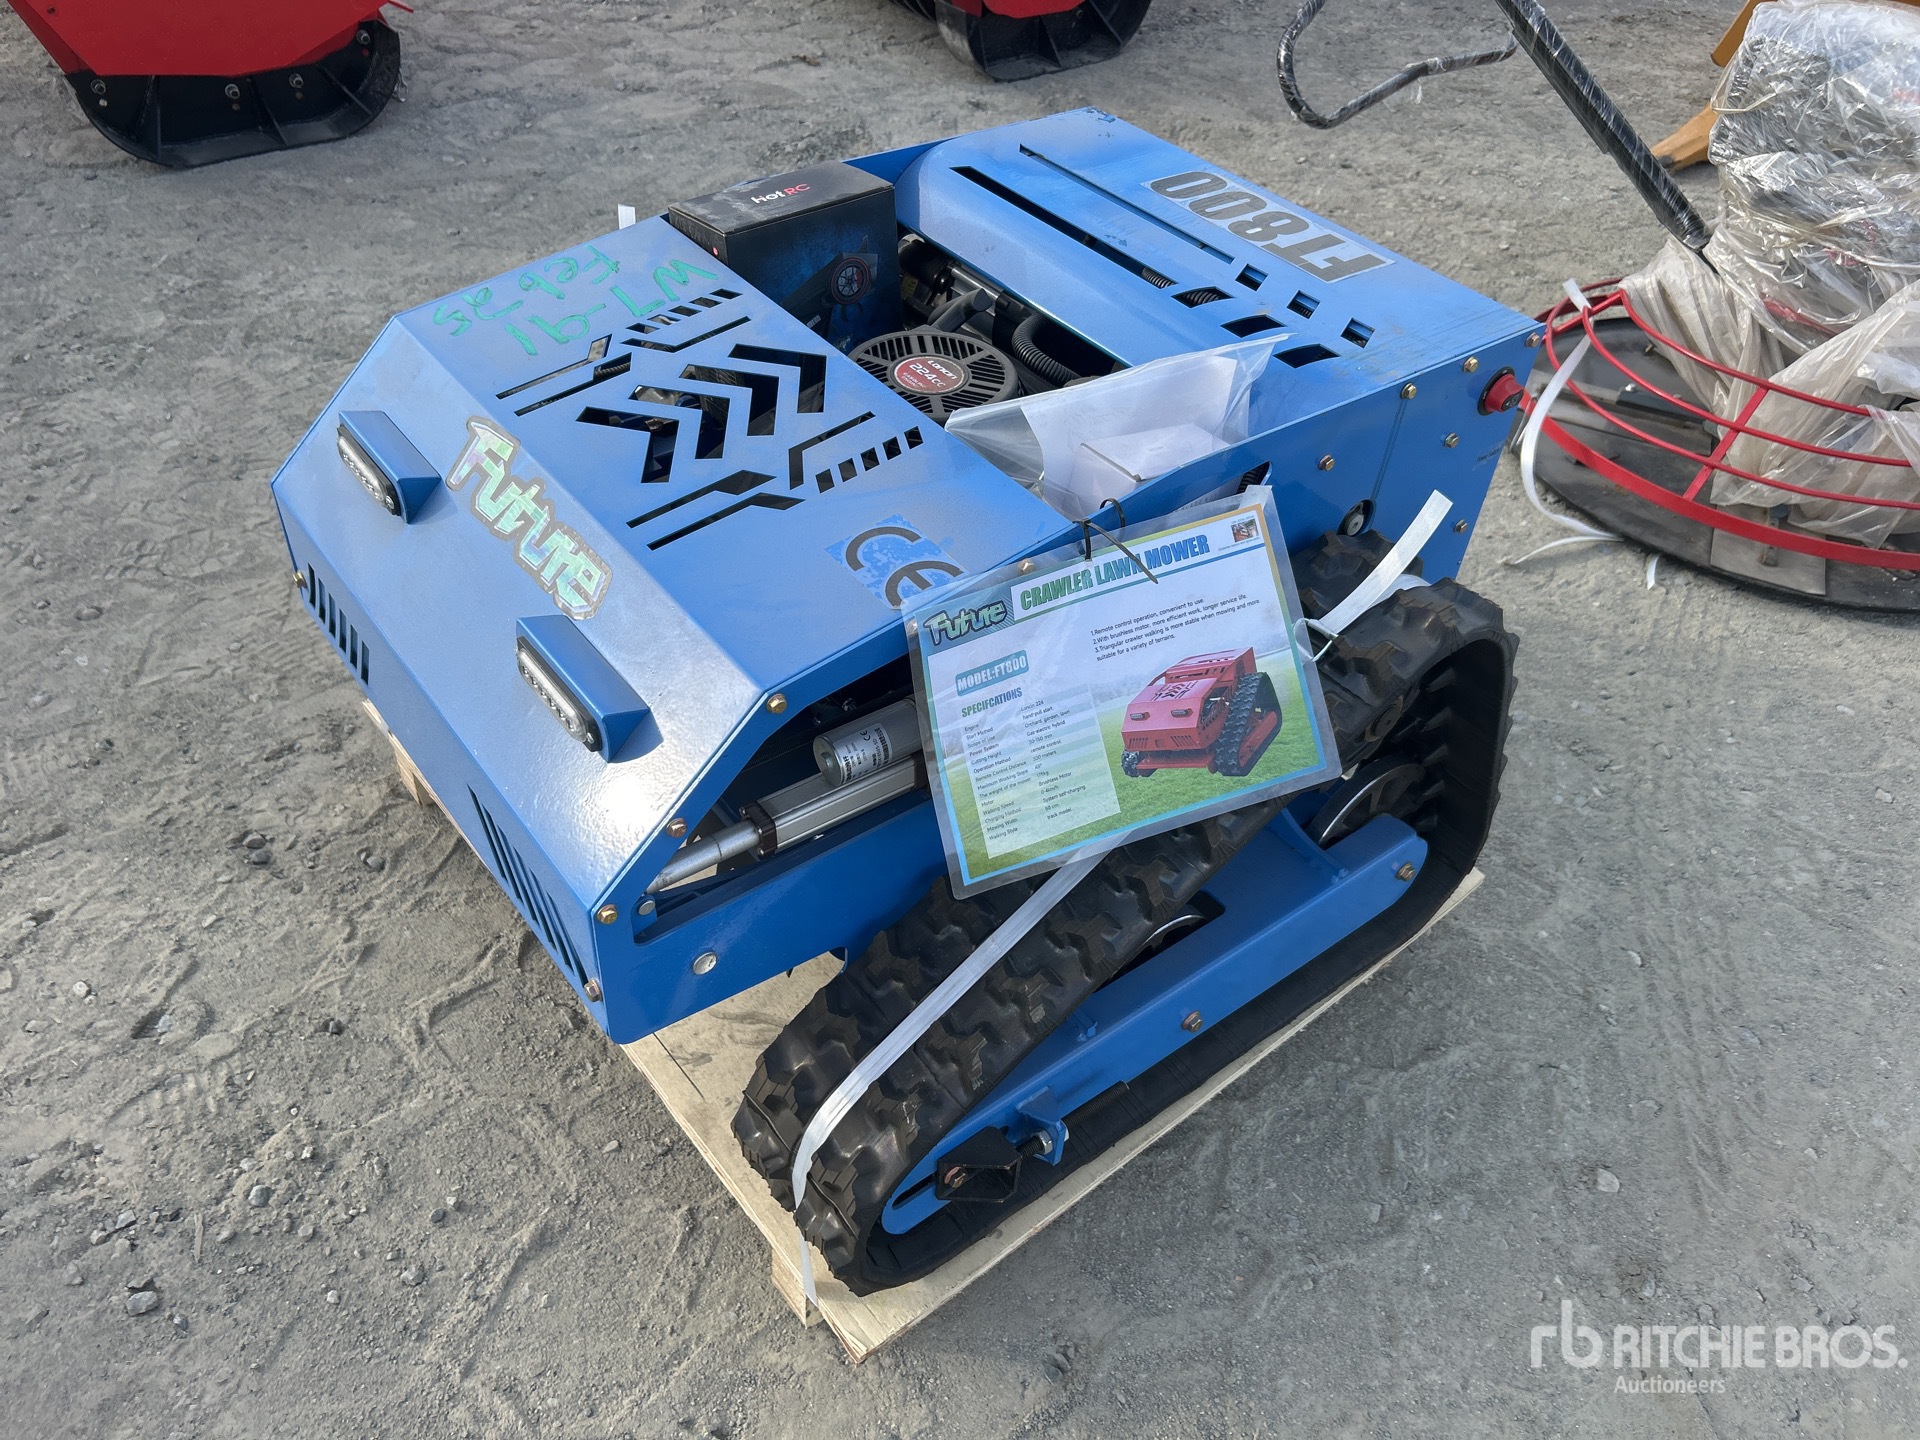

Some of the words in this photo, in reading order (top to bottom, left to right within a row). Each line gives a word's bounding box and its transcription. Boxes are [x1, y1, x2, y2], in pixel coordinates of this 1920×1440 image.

[1150, 171, 1387, 282] FT800
[518, 244, 620, 300] Feb
[447, 417, 611, 619] Future
[1019, 568, 1094, 611] CRAWLER
[1094, 552, 1143, 585] LAWN
[1144, 534, 1211, 570] MOWER
[923, 600, 1008, 646] Future
[1110, 628, 1134, 640] brushless
[1152, 619, 1166, 627] more
[1166, 612, 1187, 622] efficient
[1202, 602, 1219, 612] longer
[1220, 597, 1238, 606] service
[1114, 618, 1133, 629] control
[1159, 603, 1187, 616] convenient
[1124, 633, 1144, 643] crawler
[1144, 628, 1164, 639] walking
[1170, 621, 1184, 630] more
[1184, 616, 1200, 626] stable
[1201, 612, 1215, 621] when
[1215, 606, 1236, 617] mowing
[1236, 602, 1247, 610] and
[1247, 599, 1260, 607] more
[1096, 651, 1117, 662] suitable
[1117, 647, 1125, 655] for
[1130, 641, 1148, 652] variety
[957, 655, 1027, 692] MODEL:FT800
[961, 686, 1023, 718] SPECIFCATIONS
[964, 723, 980, 732] Engine
[969, 748, 983, 757] Power
[983, 743, 1000, 752] System
[973, 763, 995, 774] Operation
[994, 756, 1012, 766] Method
